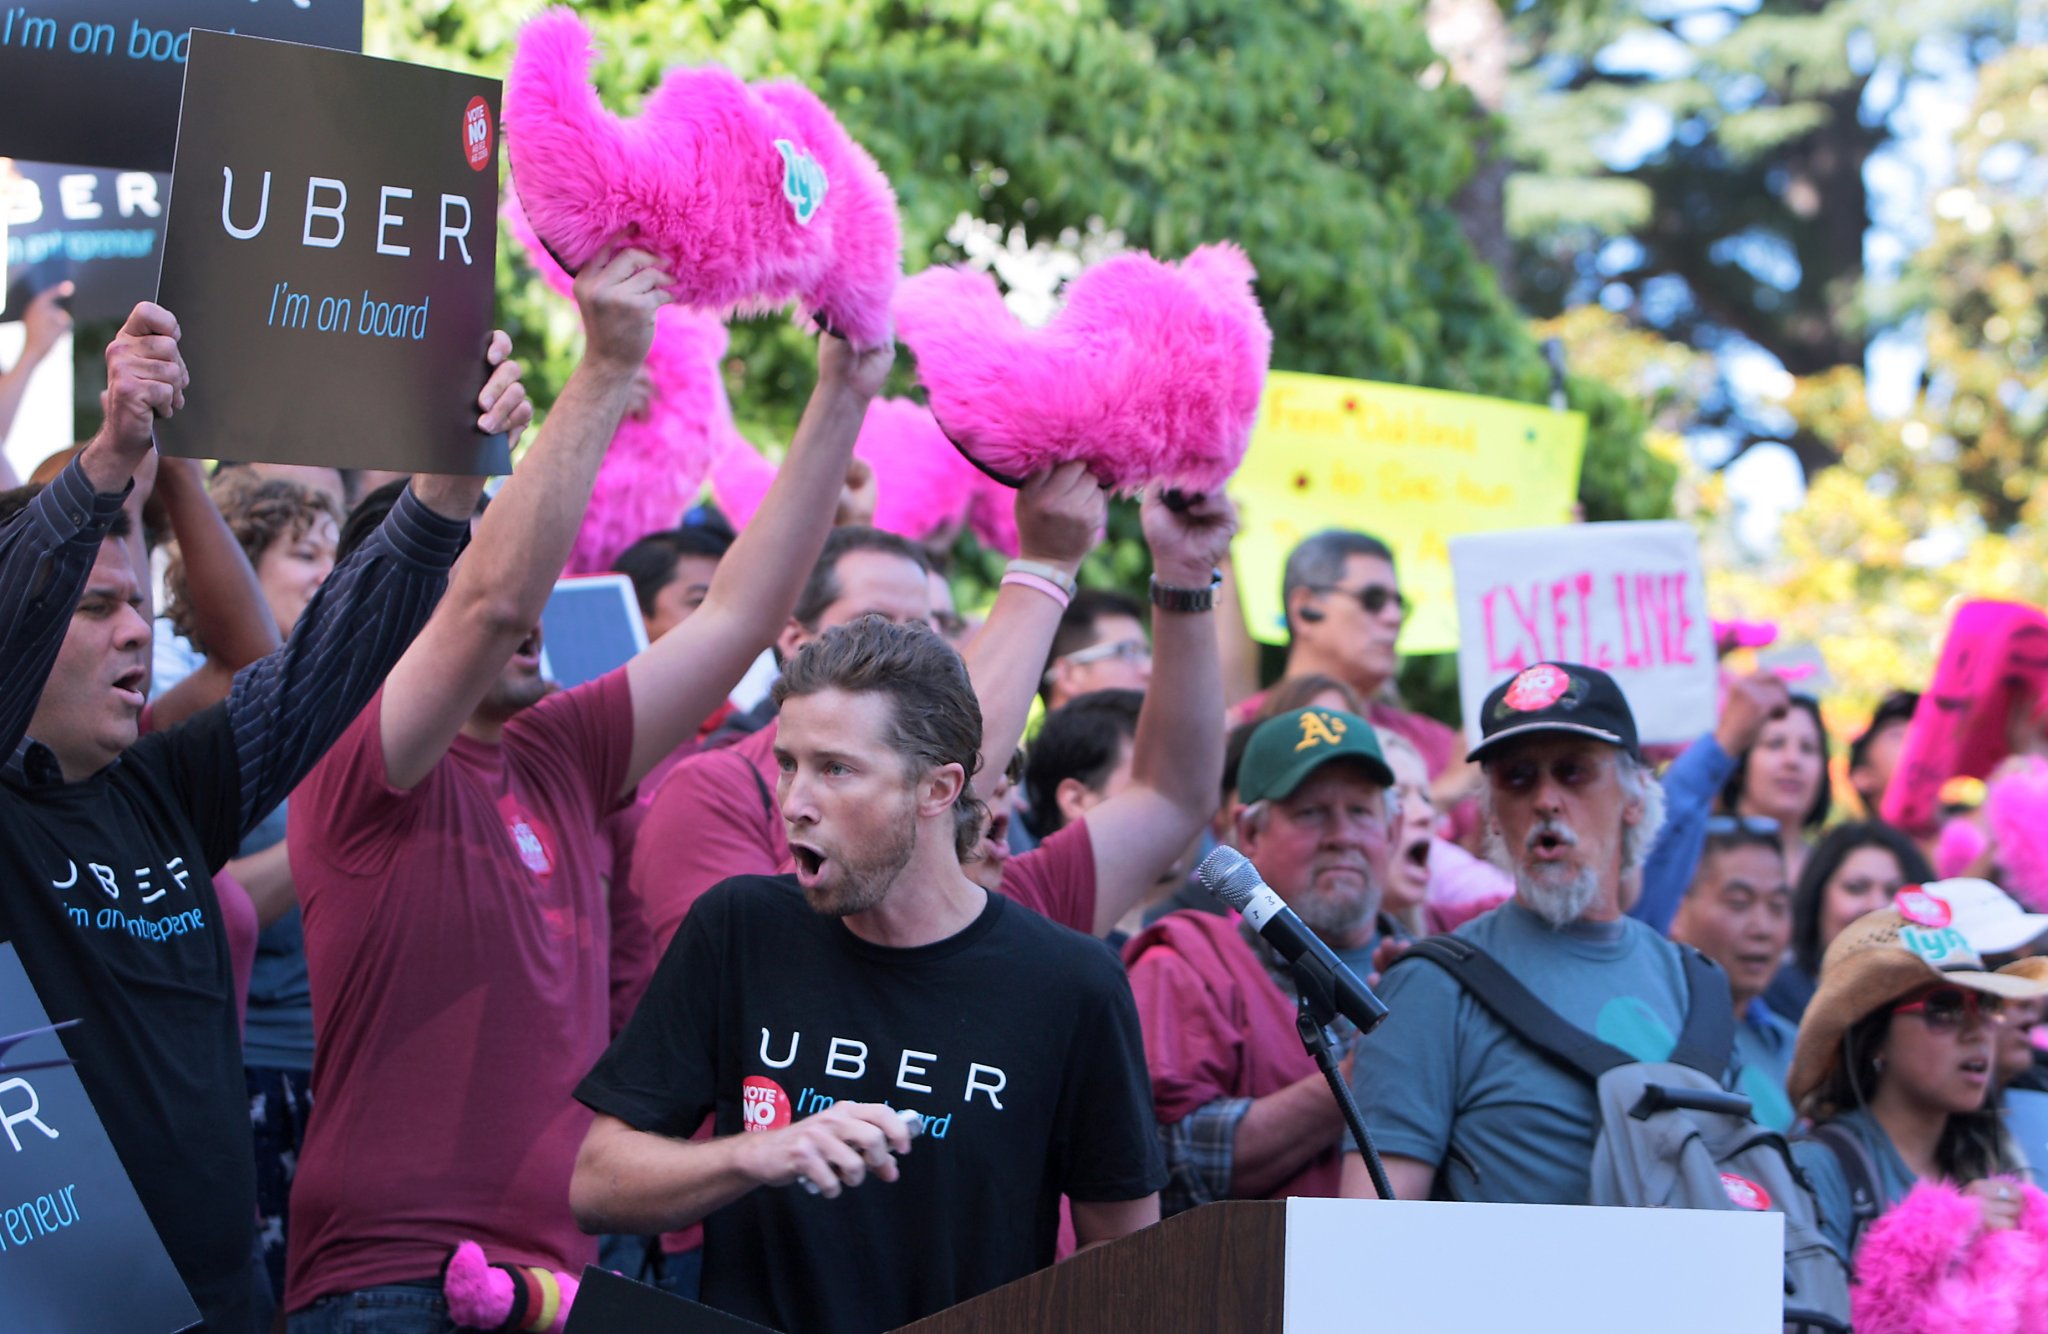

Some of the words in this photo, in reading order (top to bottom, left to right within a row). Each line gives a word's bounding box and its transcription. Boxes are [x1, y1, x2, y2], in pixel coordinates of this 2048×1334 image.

[3, 7, 57, 48] I'm
[68, 21, 116, 56] on
[467, 104, 485, 123] VOTE
[468, 119, 488, 146] NO
[221, 165, 474, 266] UBER
[267, 281, 311, 329] I'm
[317, 296, 351, 333] on
[357, 289, 430, 340] board
[1294, 711, 1347, 752] A's
[759, 1027, 1007, 1110] UBER
[743, 1099, 776, 1126] NO
[797, 1087, 834, 1114] I'm
